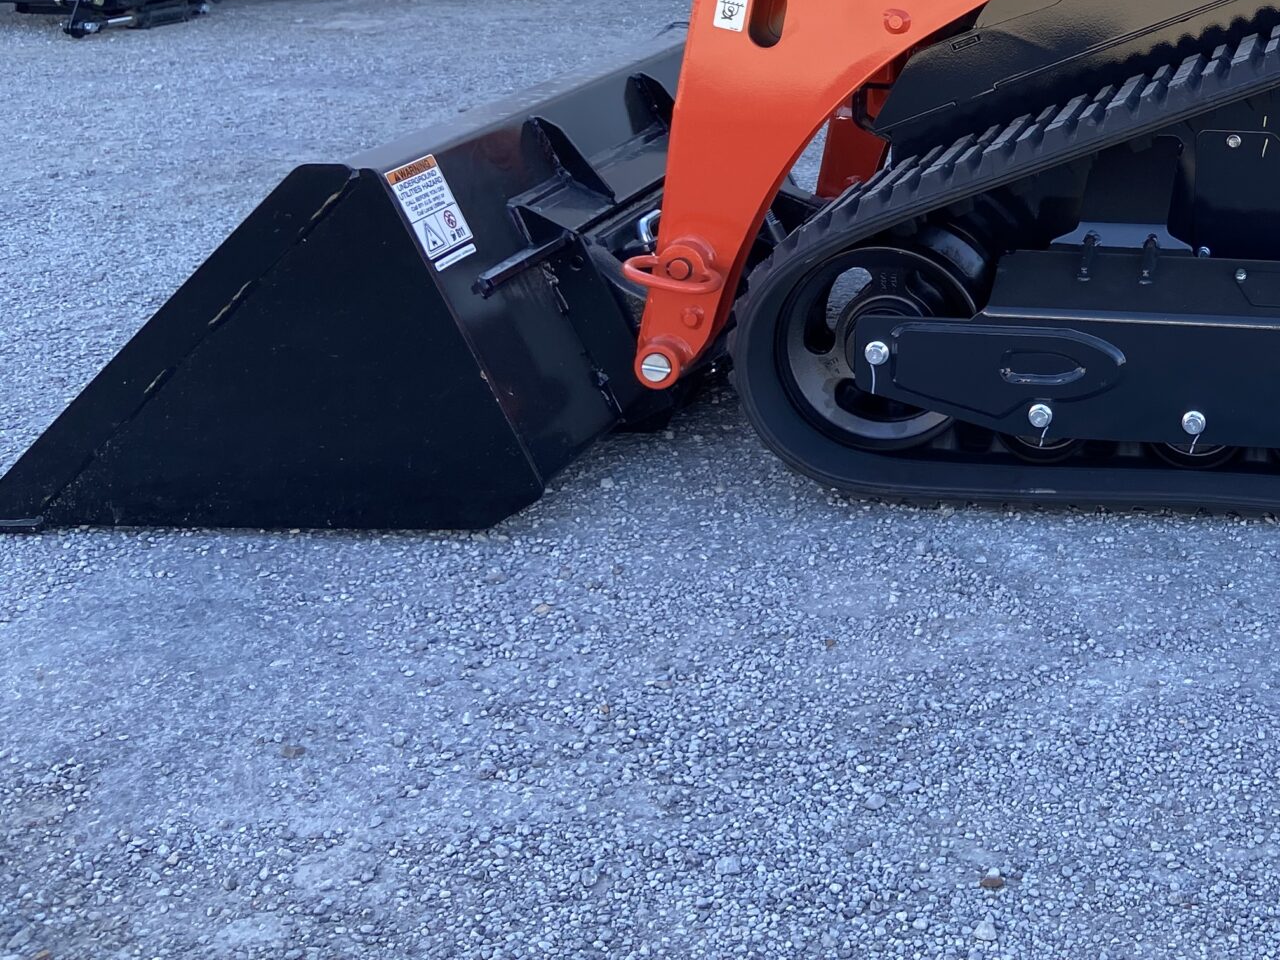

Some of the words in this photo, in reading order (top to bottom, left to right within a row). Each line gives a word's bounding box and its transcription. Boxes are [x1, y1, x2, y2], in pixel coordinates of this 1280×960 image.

[396, 169, 437, 192] UNDERGROUND
[400, 159, 431, 181] WARNING
[399, 186, 422, 201] UTILITIES
[422, 176, 443, 190] HAZARD
